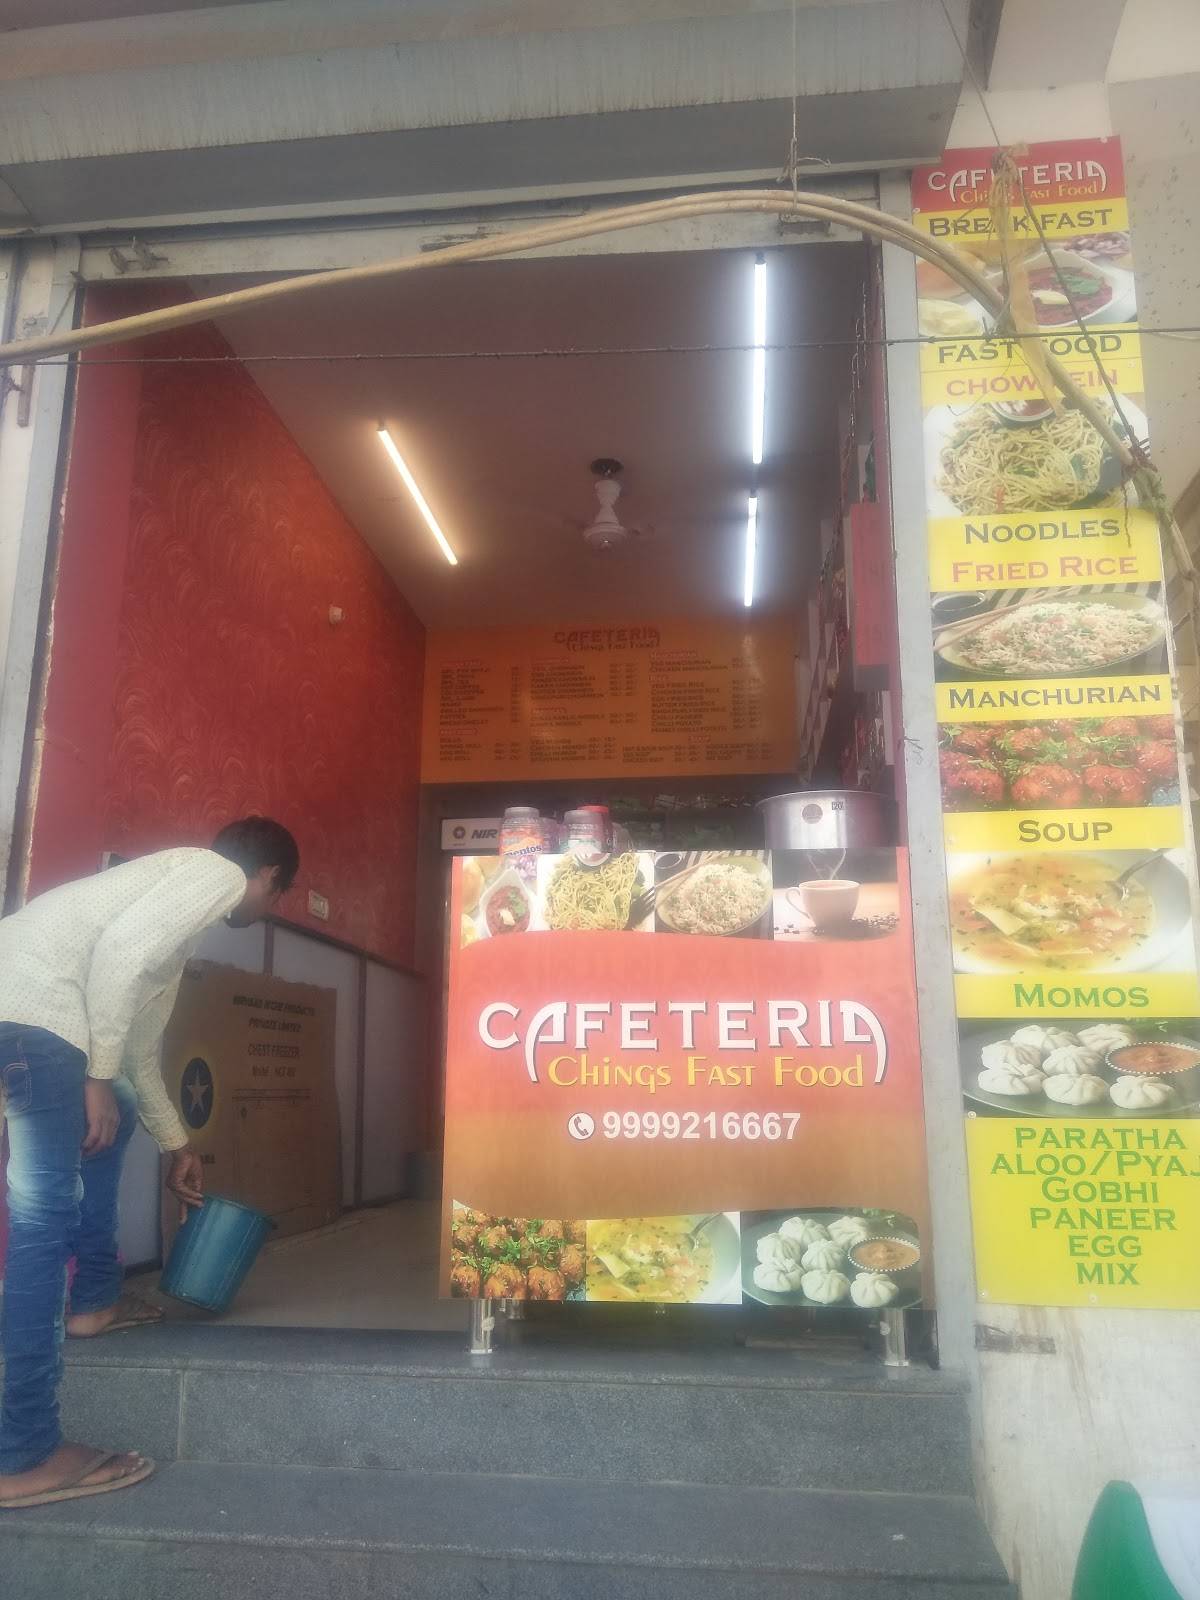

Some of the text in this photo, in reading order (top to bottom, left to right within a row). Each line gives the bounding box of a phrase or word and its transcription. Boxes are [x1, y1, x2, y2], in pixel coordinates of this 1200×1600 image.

[928, 160, 1107, 202] CAFTERIA
[1058, 182, 1098, 197] Food
[938, 334, 1122, 364] FAST OOD
[946, 369, 1119, 397] CHOWEIN
[964, 518, 1121, 545] NOODLES
[952, 556, 1139, 583] FRIED RICE
[553, 627, 661, 651] CAFETERIA
[949, 684, 1161, 709] MANCHURIAN
[1018, 819, 1113, 843] SOUP
[1014, 983, 1150, 1008] MOMOS
[478, 1000, 888, 1084] CAFETERIA
[774, 1054, 864, 1087] Food
[602, 1111, 802, 1141] 9999216667
[1014, 1127, 1187, 1150] PARATHA
[1041, 1176, 1160, 1203] GOBHI
[1029, 1207, 1178, 1231] PANEER
[1068, 1235, 1143, 1258] EGG
[1075, 1262, 1141, 1285] MIX
